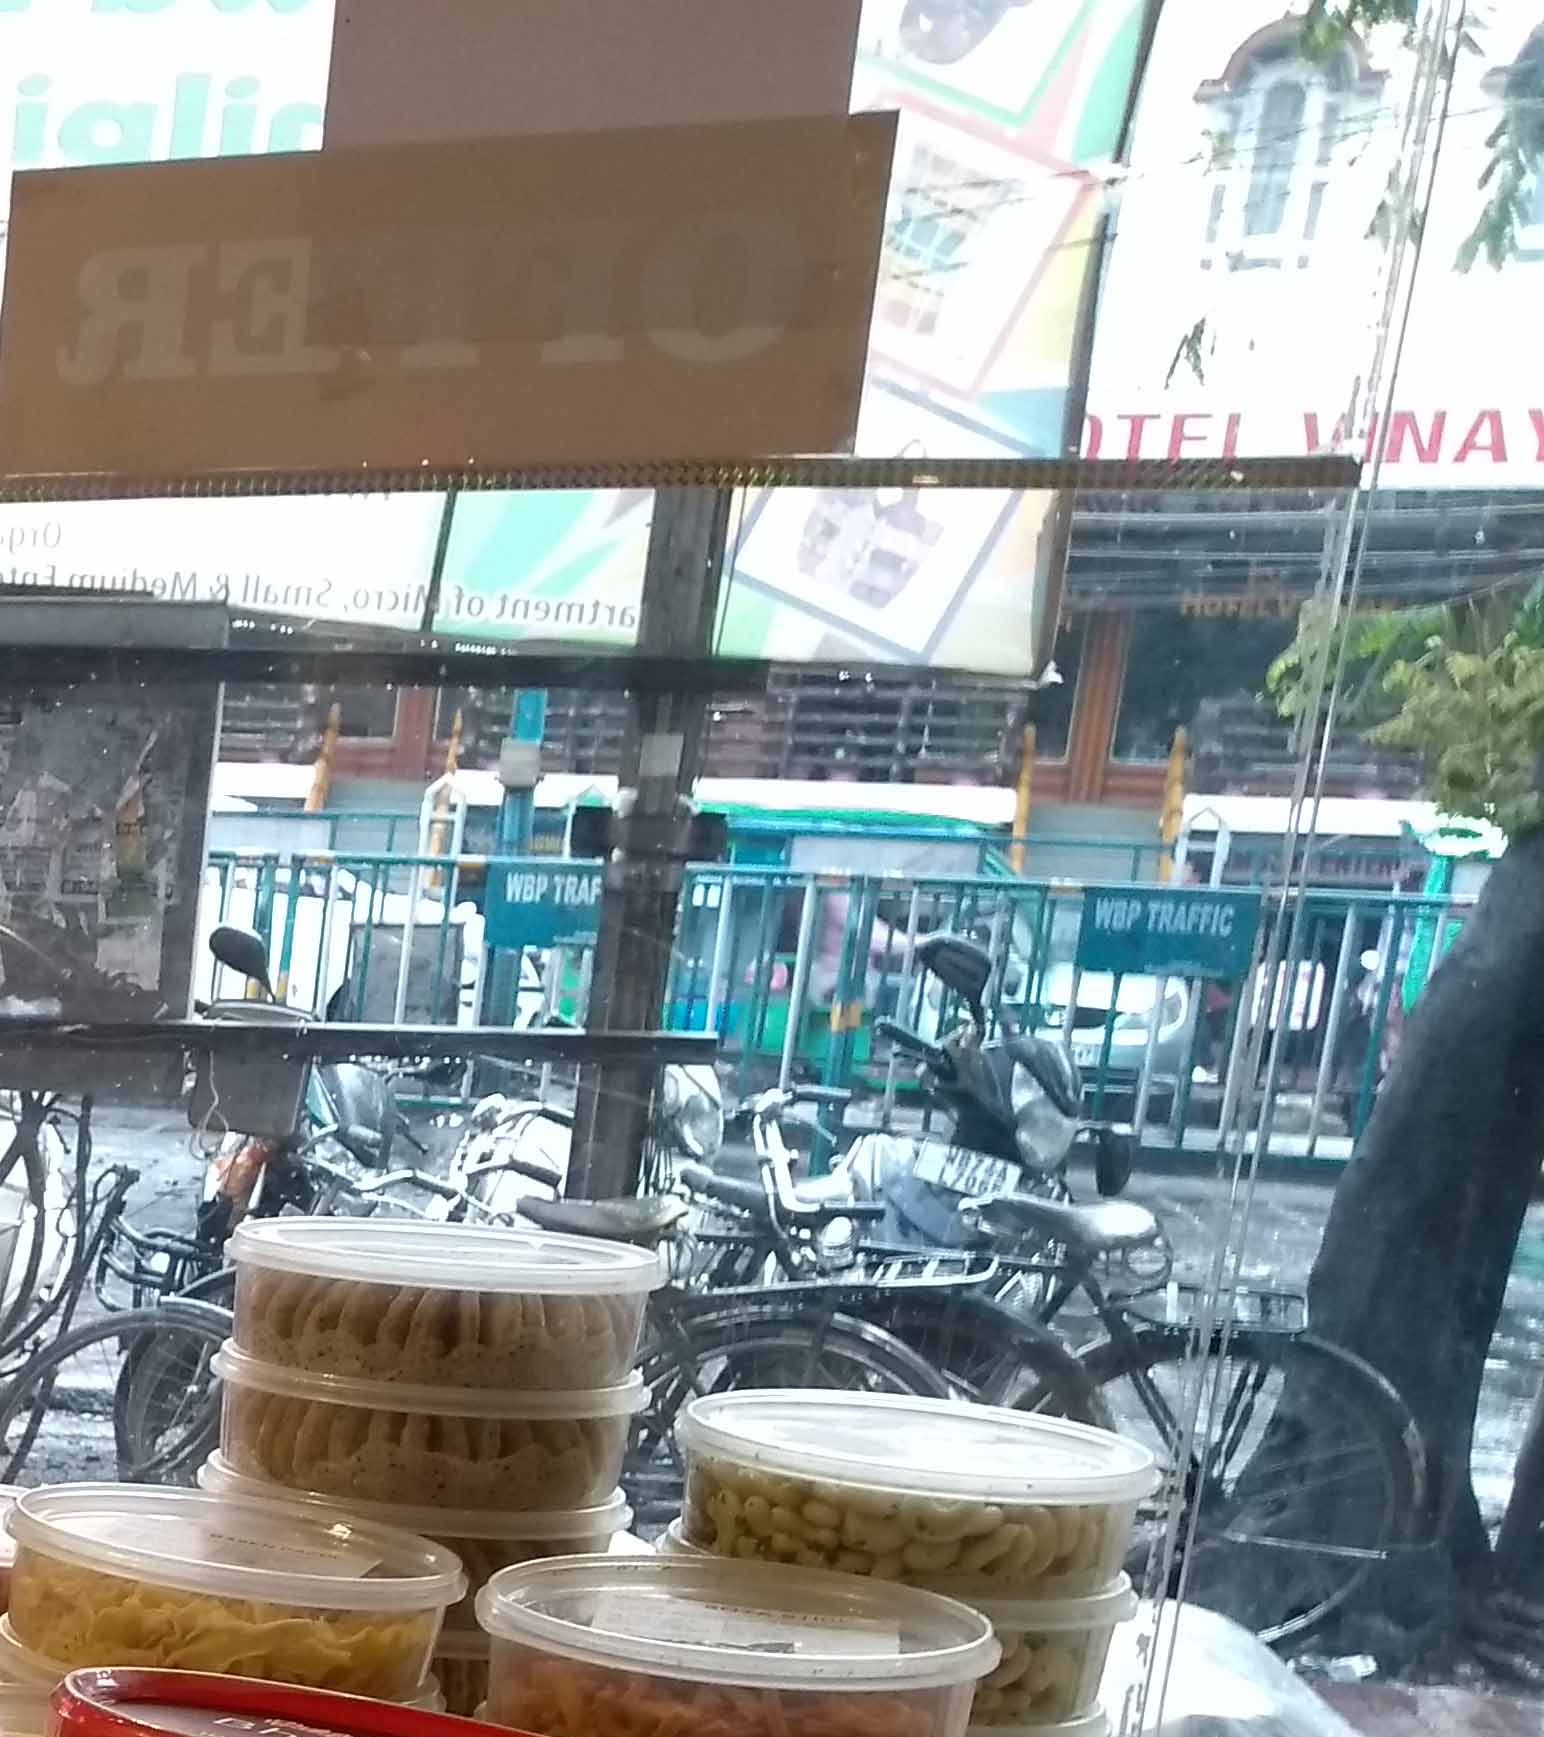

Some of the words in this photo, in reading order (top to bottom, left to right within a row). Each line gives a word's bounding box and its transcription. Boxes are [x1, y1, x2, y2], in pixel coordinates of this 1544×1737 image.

[506, 871, 549, 904] WBP
[1094, 896, 1142, 933] WBP
[1148, 899, 1235, 937] TRAFFIC
